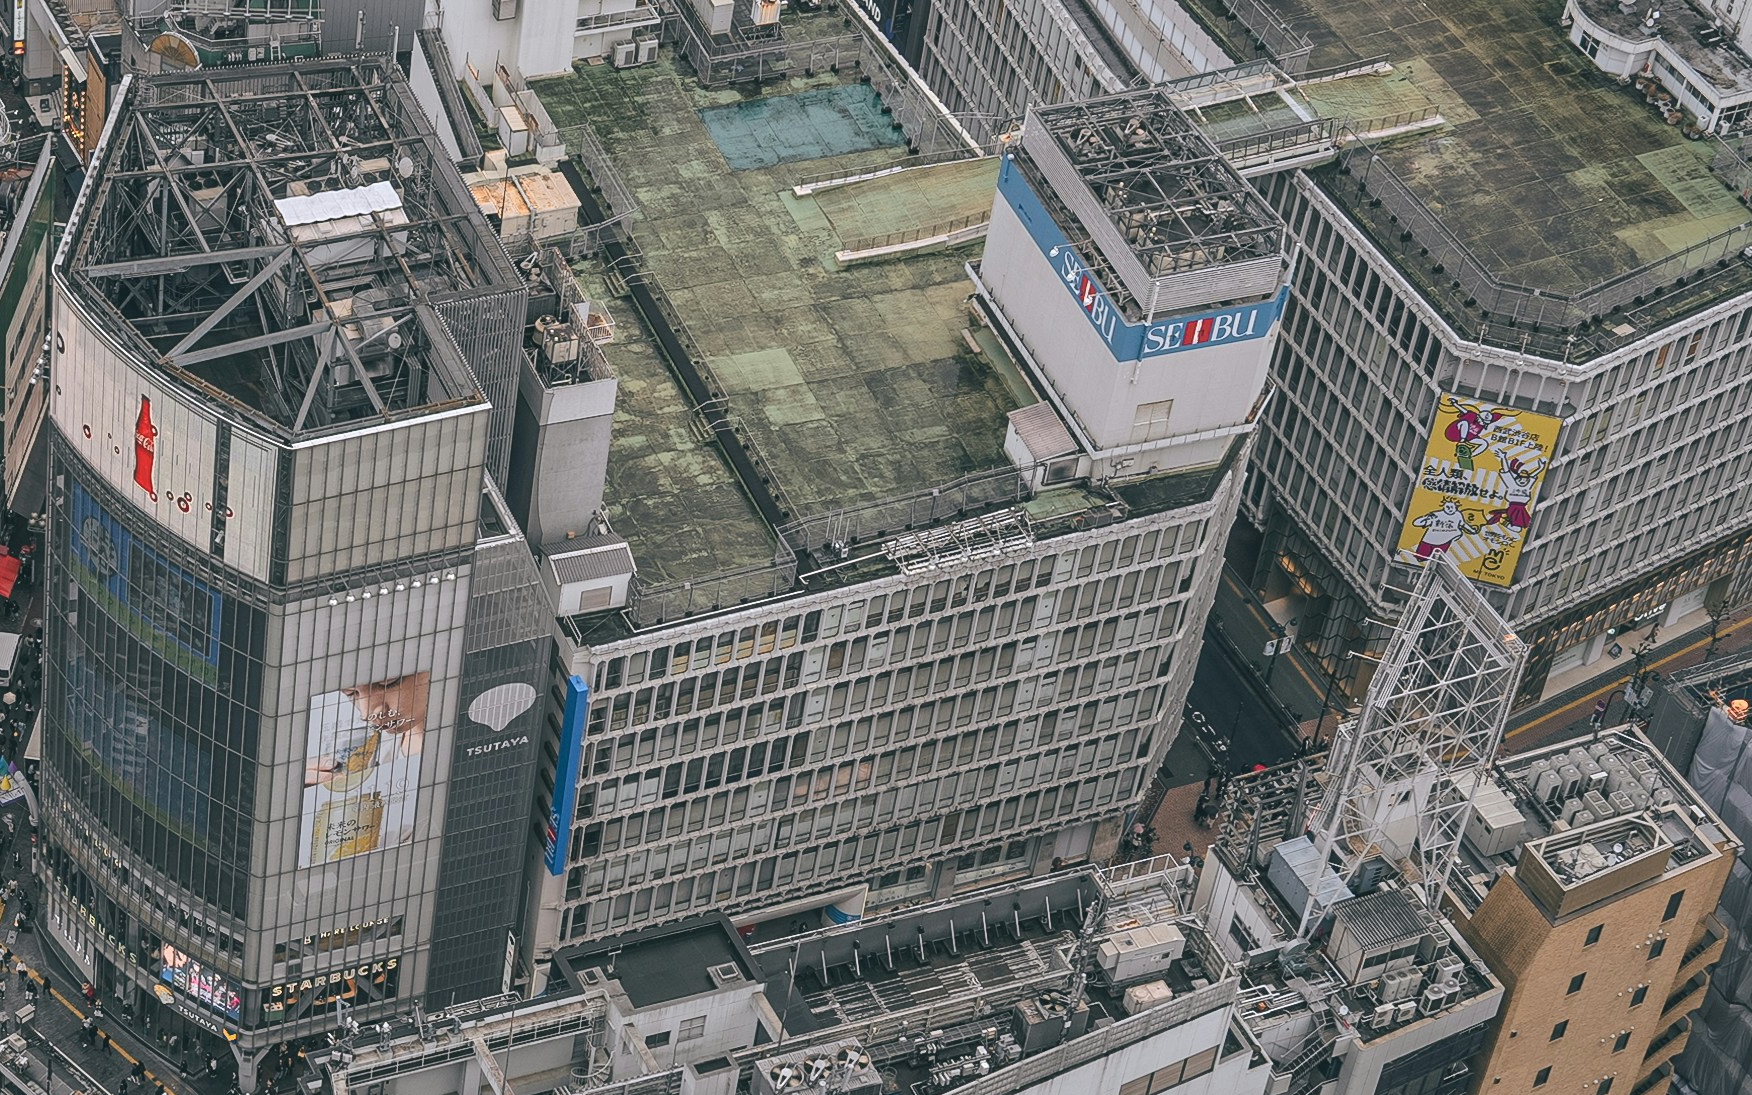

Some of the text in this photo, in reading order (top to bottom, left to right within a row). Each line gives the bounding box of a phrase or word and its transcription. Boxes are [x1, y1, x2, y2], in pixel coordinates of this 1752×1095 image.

[1493, 424, 1540, 442] 西武渋谷店
[1424, 464, 1469, 481] 全人類、
[1422, 476, 1504, 501] 感情解放せよ。
[1485, 571, 1505, 580] TOKYO
[467, 735, 529, 756] TSUTAYA
[325, 824, 376, 838] レモンサワー
[56, 876, 138, 963] STARBUCKS
[272, 958, 398, 997] STARBUCKS
[178, 1005, 219, 1032] TSUTAYA
